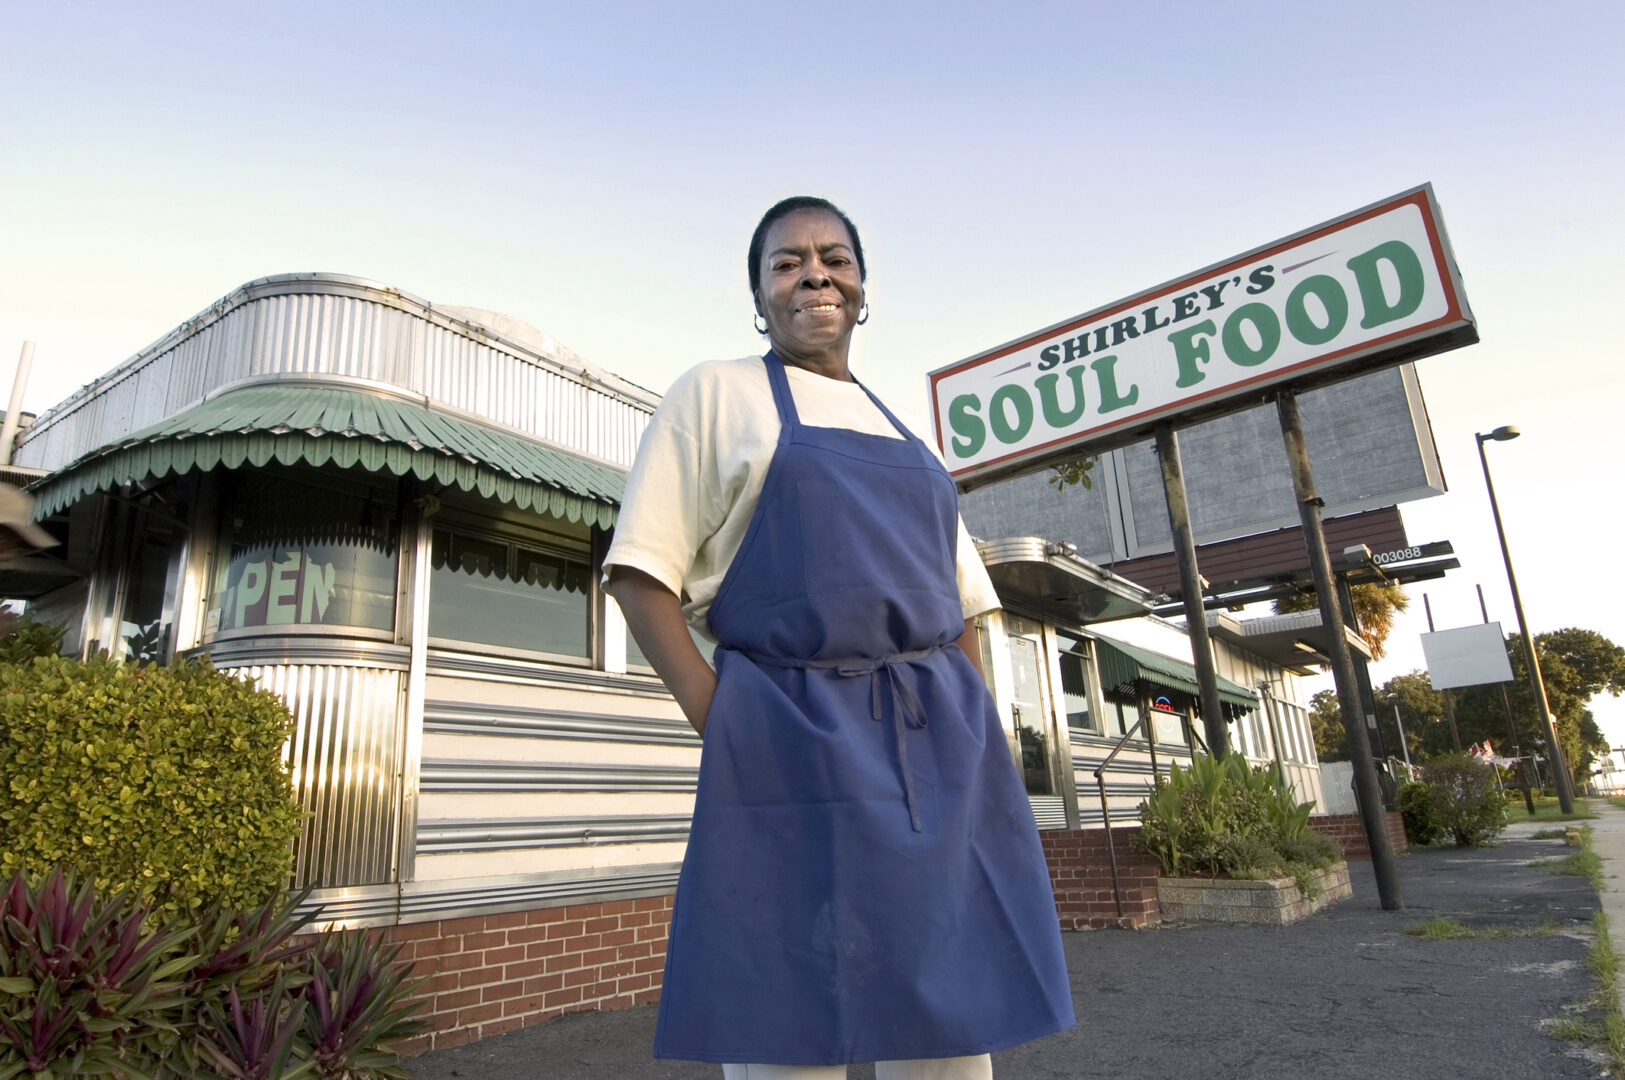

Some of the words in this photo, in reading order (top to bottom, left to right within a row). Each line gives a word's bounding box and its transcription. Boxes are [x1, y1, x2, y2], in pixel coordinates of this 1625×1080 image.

[949, 355, 1139, 459] SOUL
[1167, 240, 1425, 388] FOOD
[1038, 265, 1275, 371] SHIRLEY'S
[1373, 547, 1421, 564] 003088
